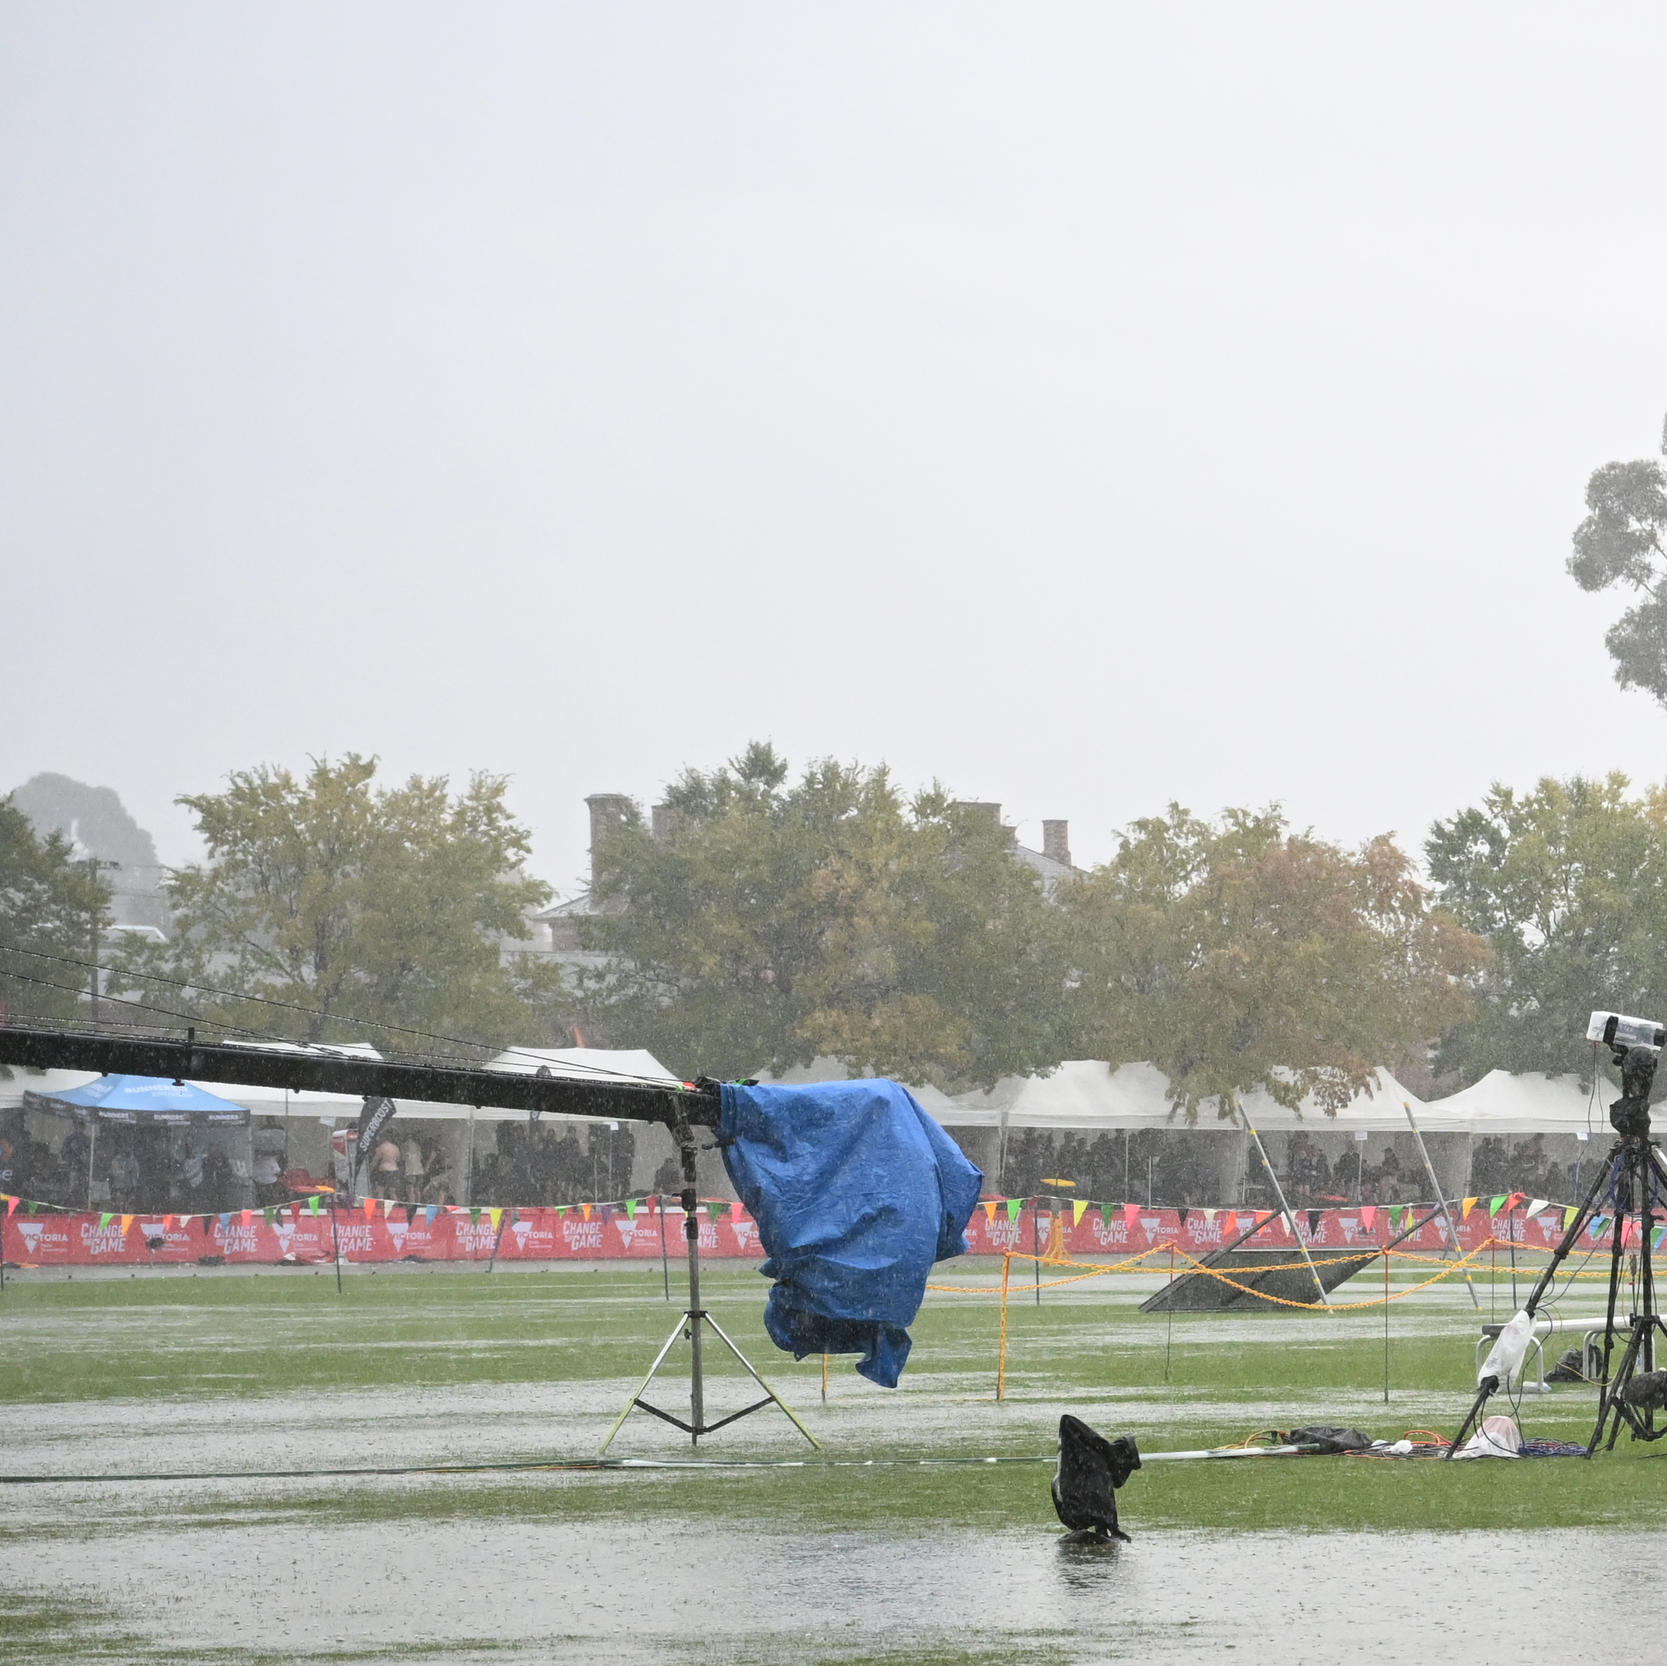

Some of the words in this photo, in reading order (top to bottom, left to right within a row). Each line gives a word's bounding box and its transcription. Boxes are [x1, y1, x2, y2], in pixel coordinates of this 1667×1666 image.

[359, 1099, 393, 1152] SUPERBOOST
[562, 1220, 602, 1235] CHANGE
[680, 1220, 718, 1235] CNGE
[465, 1235, 498, 1251] GAME
[571, 1234, 604, 1250] GAME
[1100, 1231, 1129, 1246] GAME
[1194, 1231, 1223, 1244] GAME
[90, 1238, 127, 1255] GAME
[223, 1239, 258, 1255] GAME
[340, 1238, 373, 1253] GAME
